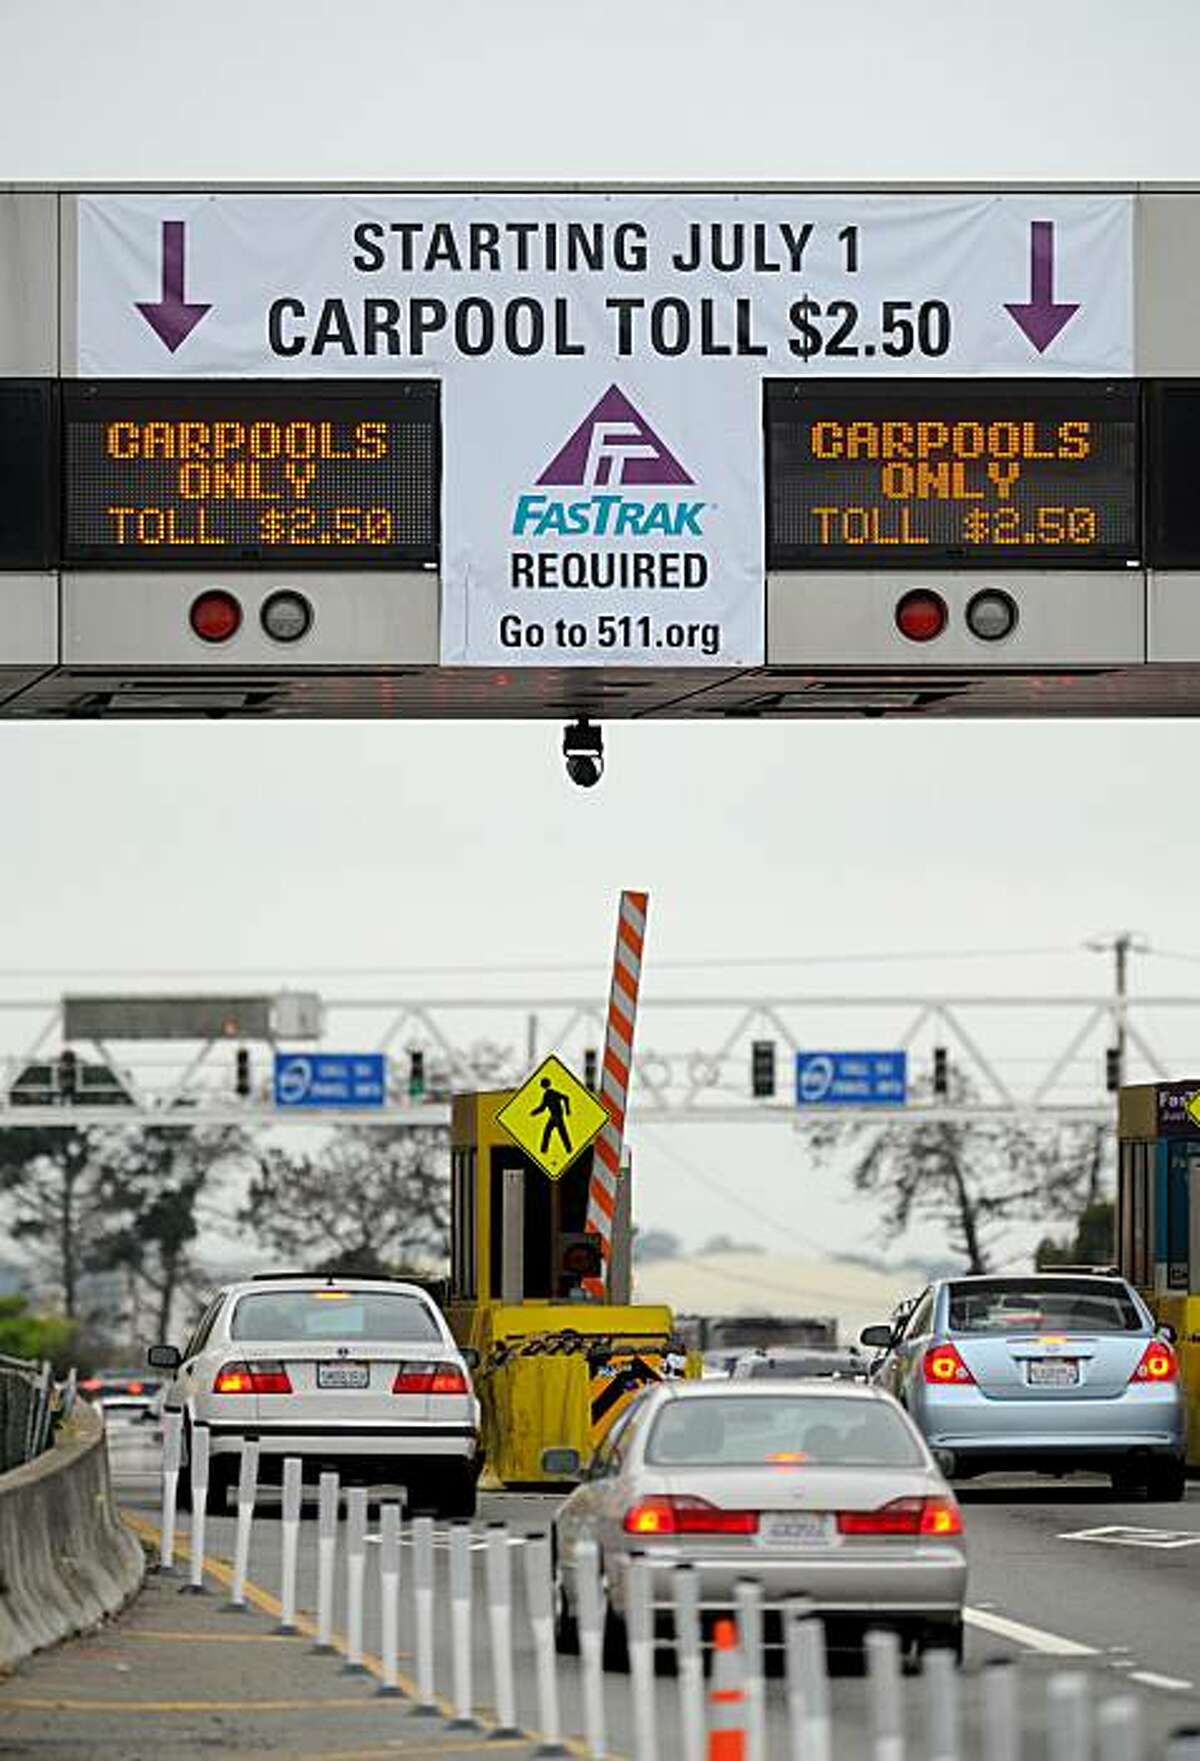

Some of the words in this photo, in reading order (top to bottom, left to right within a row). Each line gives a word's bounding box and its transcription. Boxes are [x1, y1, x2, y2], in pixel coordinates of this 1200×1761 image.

[354, 222, 646, 273] STARTING
[672, 223, 814, 273] JULY
[838, 224, 858, 273] 1
[268, 297, 585, 357] CARPOOL
[605, 297, 767, 357] TOLL
[788, 294, 951, 363] $2.50
[107, 421, 388, 459] CARPOOLS
[811, 421, 1090, 459] CARPOOLS
[179, 461, 317, 499] ONLY
[881, 461, 1020, 499] ONLY
[108, 507, 226, 544] TOLL
[260, 507, 391, 544] $2.50
[811, 507, 928, 544] TOLL
[963, 507, 1098, 544] $2.50
[511, 552, 708, 588] REQUIRED
[500, 614, 544, 648] Go
[555, 619, 587, 648] to
[598, 615, 720, 655] 511.org
